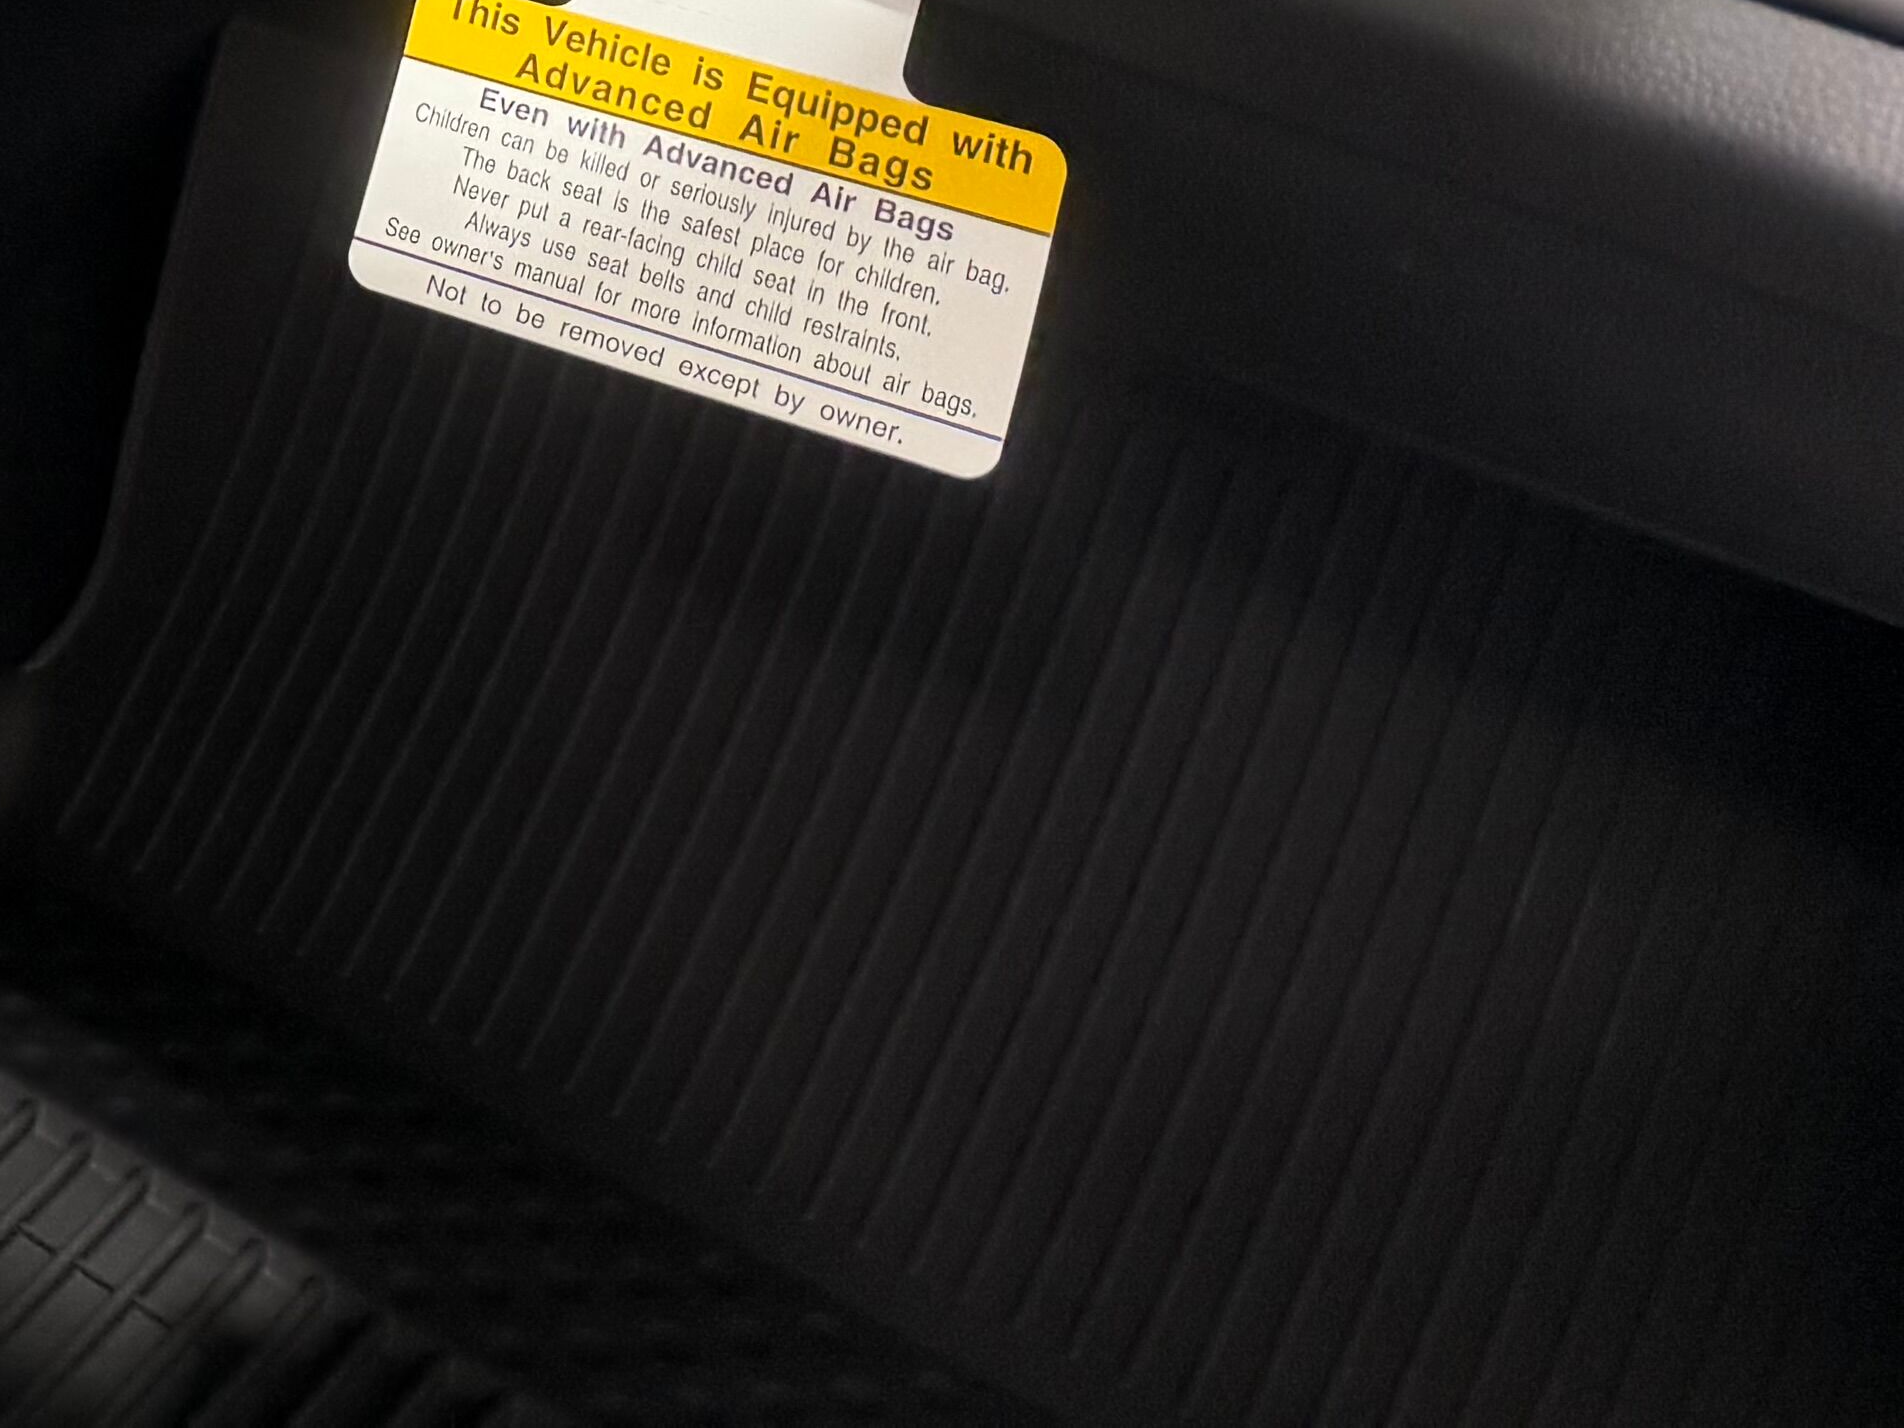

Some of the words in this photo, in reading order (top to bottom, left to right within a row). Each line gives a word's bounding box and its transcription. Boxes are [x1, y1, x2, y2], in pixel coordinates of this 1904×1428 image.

[479, 87, 549, 127] Even
[568, 116, 626, 150] with
[642, 134, 794, 197] Advanced
[809, 181, 858, 213] Air
[873, 197, 954, 242] Bags
[514, 52, 713, 131] Advanced
[737, 113, 801, 154] Air
[827, 135, 933, 191] Bags
[545, 15, 671, 76] Vehicle
[692, 55, 724, 91] is
[746, 70, 930, 147] Equipped
[952, 130, 1033, 176] with
[415, 102, 491, 142] Children
[500, 131, 535, 154] can
[545, 138, 569, 164] be
[579, 148, 631, 182] killed
[639, 171, 661, 191] or
[670, 180, 758, 223] seriously
[767, 201, 837, 242] injured
[845, 224, 873, 257] by
[883, 236, 916, 264] the
[927, 251, 956, 275] air
[965, 258, 1009, 295] bag.
[452, 174, 510, 210] Never
[516, 199, 550, 223] put
[558, 211, 572, 229] a
[582, 218, 686, 268] rear-facing
[696, 249, 744, 280] child
[752, 268, 797, 297] seat
[806, 278, 825, 306] in
[837, 289, 869, 317] the
[880, 301, 931, 337] front.
[463, 145, 496, 174] The
[506, 158, 551, 192] back
[561, 180, 603, 207] seat
[612, 189, 630, 214] is
[640, 199, 671, 226] the
[681, 215, 741, 248] safest
[749, 232, 805, 265] place
[816, 248, 846, 278] for
[855, 263, 940, 306] children.
[385, 216, 421, 245] See
[431, 235, 504, 271] owner's
[514, 261, 586, 297] manual
[594, 280, 623, 307] for
[630, 296, 681, 326] more
[691, 309, 802, 364] information
[813, 351, 872, 386] about
[882, 372, 912, 396] air
[920, 380, 977, 419] bags.
[426, 274, 467, 306] Not
[481, 291, 502, 316] to
[515, 302, 546, 330] be
[559, 321, 666, 368] removed
[678, 359, 760, 399] except
[774, 383, 806, 416] by
[819, 403, 903, 445] owner.
[463, 210, 532, 249] Always
[542, 237, 577, 262] use
[586, 251, 630, 279] seat
[638, 261, 686, 295] belts
[696, 284, 736, 310] and
[744, 297, 793, 327] child
[802, 316, 900, 362] restraints.
